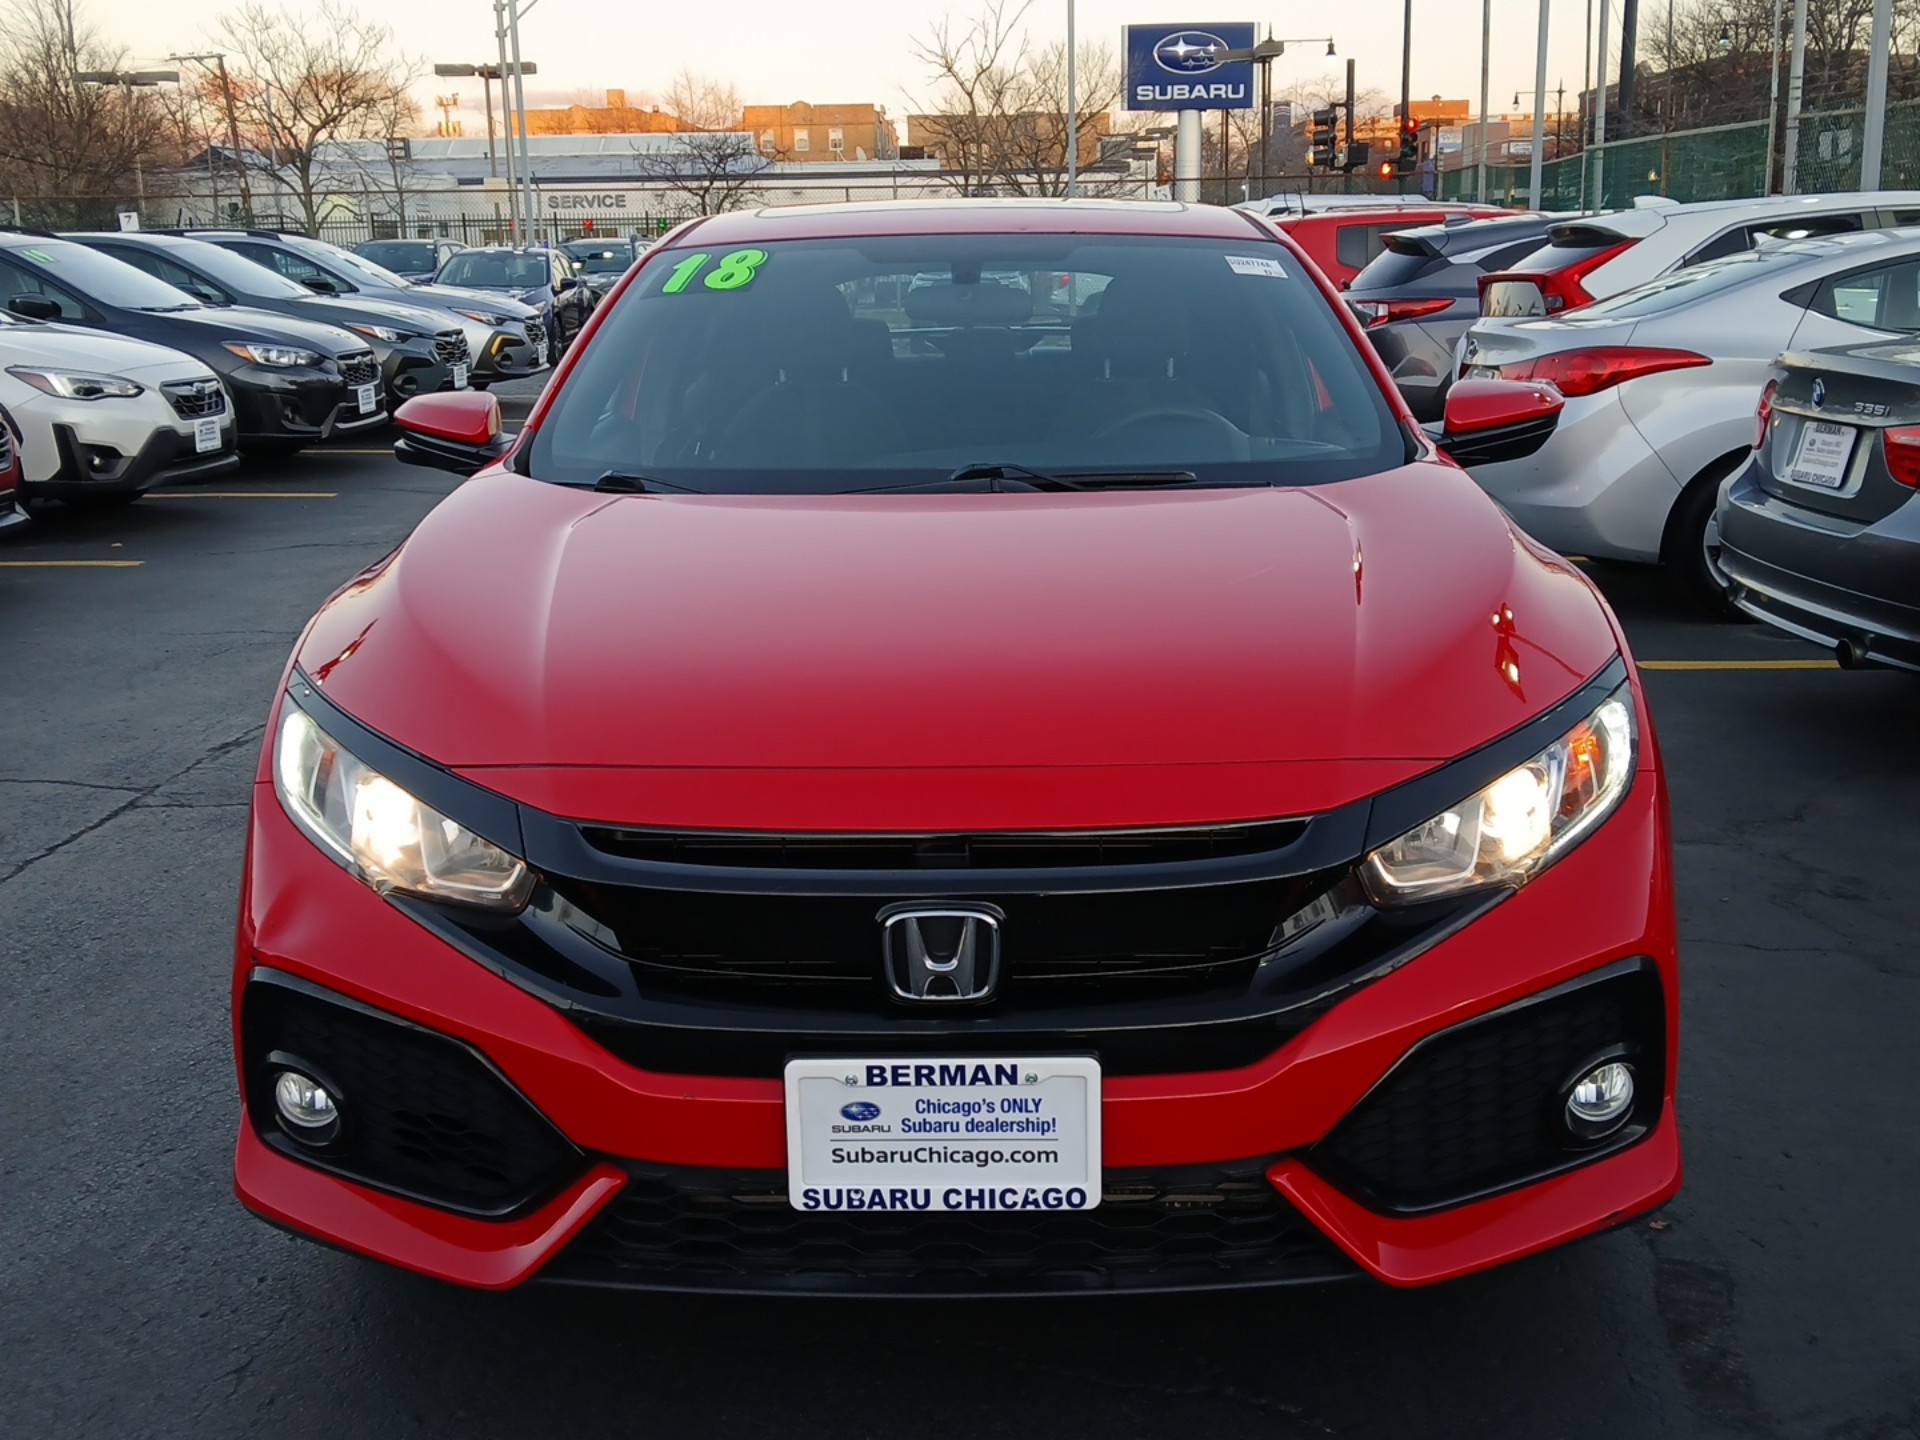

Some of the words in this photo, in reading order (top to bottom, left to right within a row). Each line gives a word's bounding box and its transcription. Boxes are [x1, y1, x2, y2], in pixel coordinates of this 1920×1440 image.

[1136, 83, 1245, 101] SUBARU
[547, 194, 627, 209] SERVICE
[123, 215, 132, 225] 7
[661, 249, 769, 294] 18
[865, 1064, 1018, 1087] BERMAN
[915, 1098, 996, 1116] Chicago's
[1000, 1098, 1042, 1114] ONLY
[831, 1124, 892, 1133] SUBARU
[901, 1117, 960, 1133] Subaru
[964, 1117, 1057, 1136] dealership!
[831, 1146, 1058, 1167] SubaruChicago.com
[802, 1188, 931, 1210] SUBARU
[942, 1187, 1088, 1209] CHICAGO
